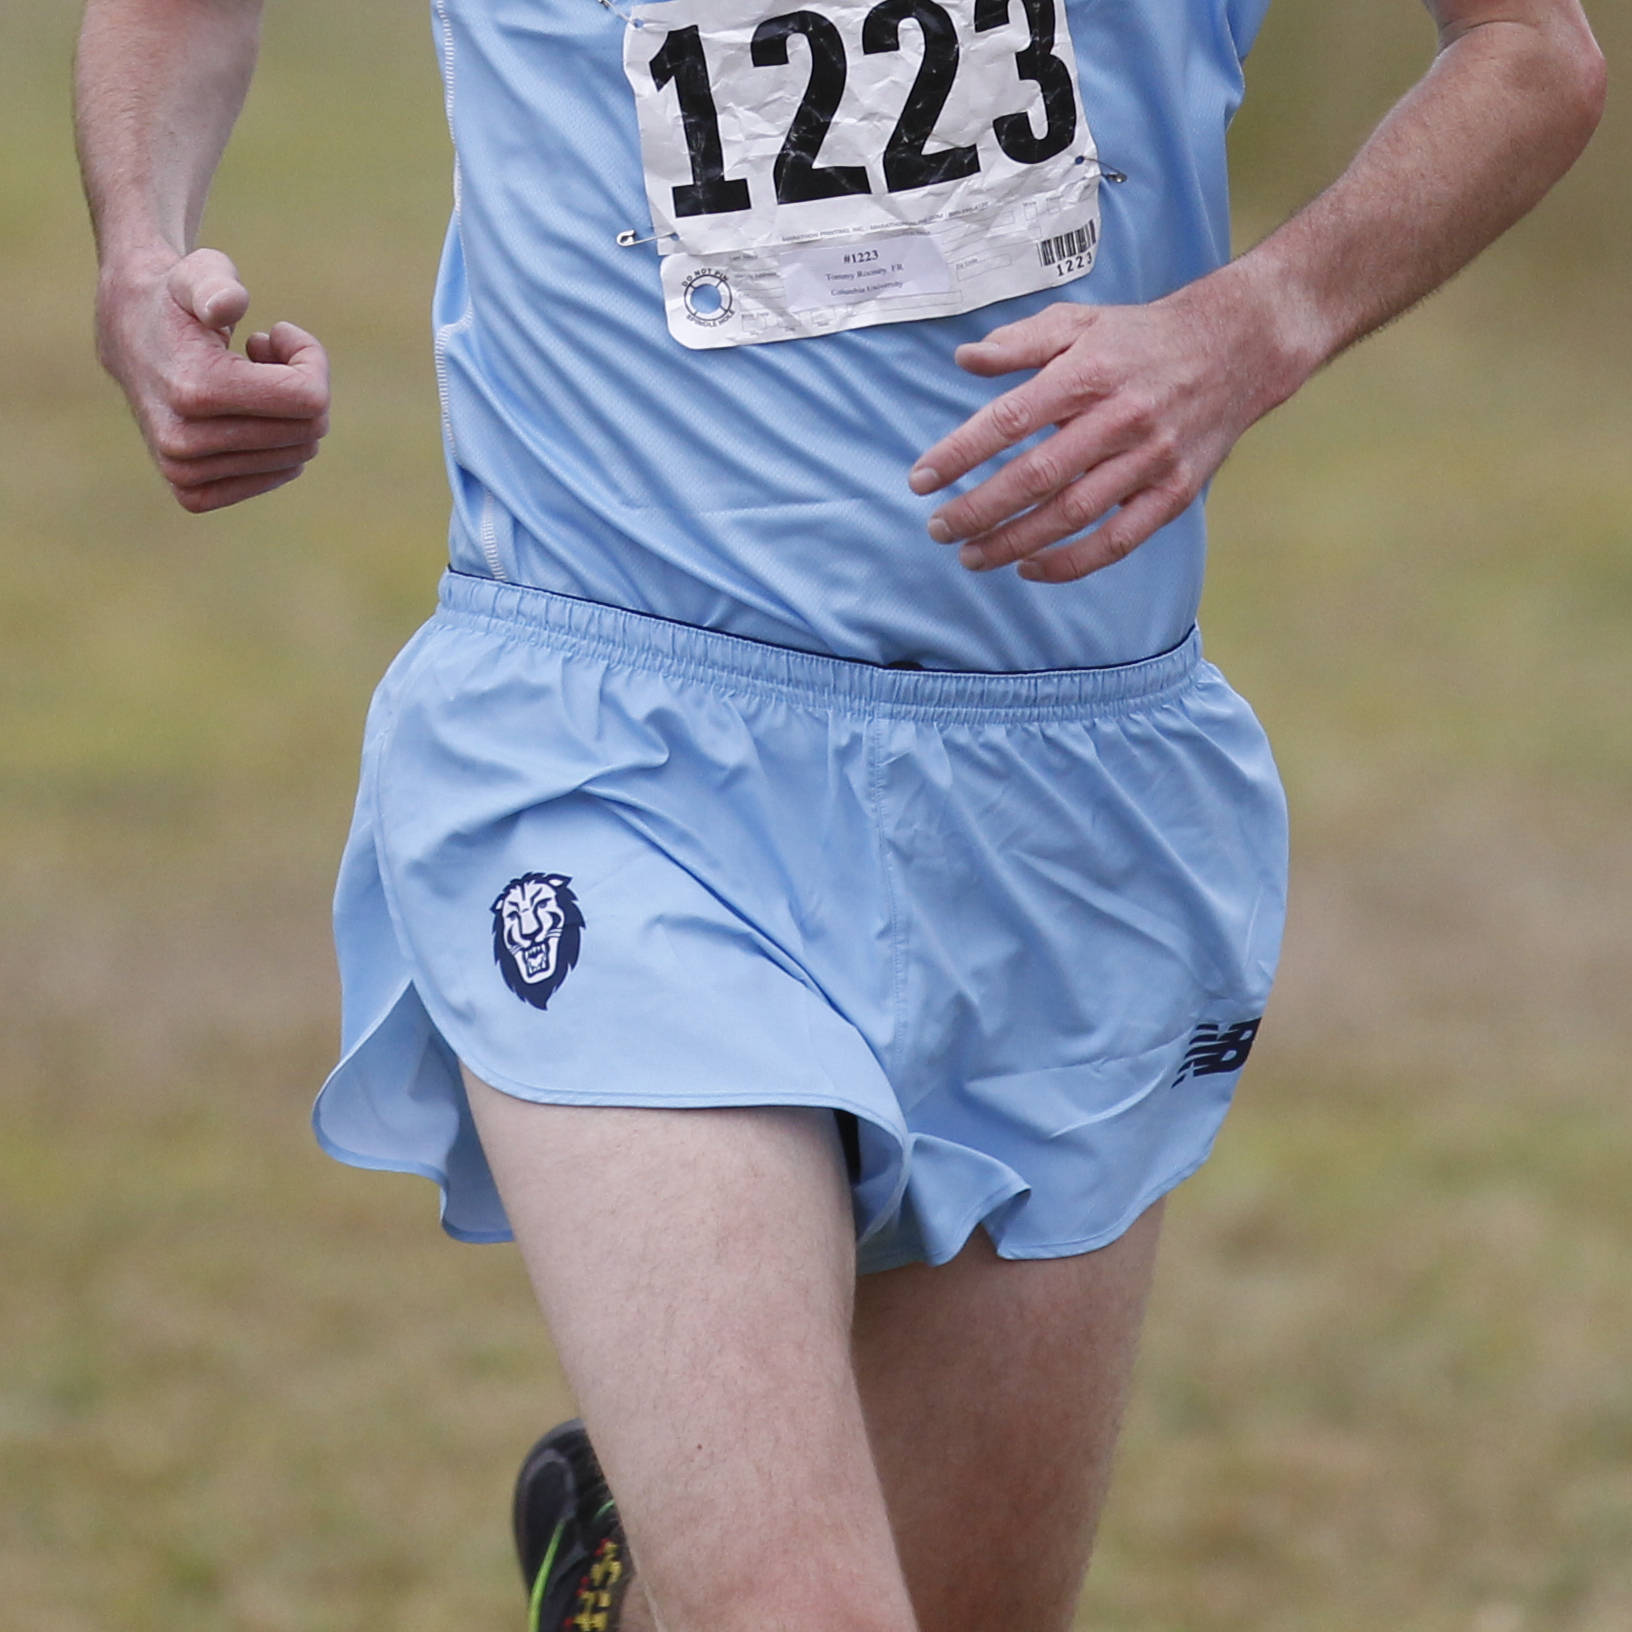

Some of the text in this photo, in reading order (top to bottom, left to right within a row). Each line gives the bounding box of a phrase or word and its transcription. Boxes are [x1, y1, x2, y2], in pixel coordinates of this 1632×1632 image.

[843, 249, 879, 264] #1223
[1056, 252, 1093, 277] 1223
[681, 275, 693, 288] DO
[694, 267, 712, 277] NOT
[714, 269, 729, 282] PIN
[830, 285, 865, 297] Columbia
